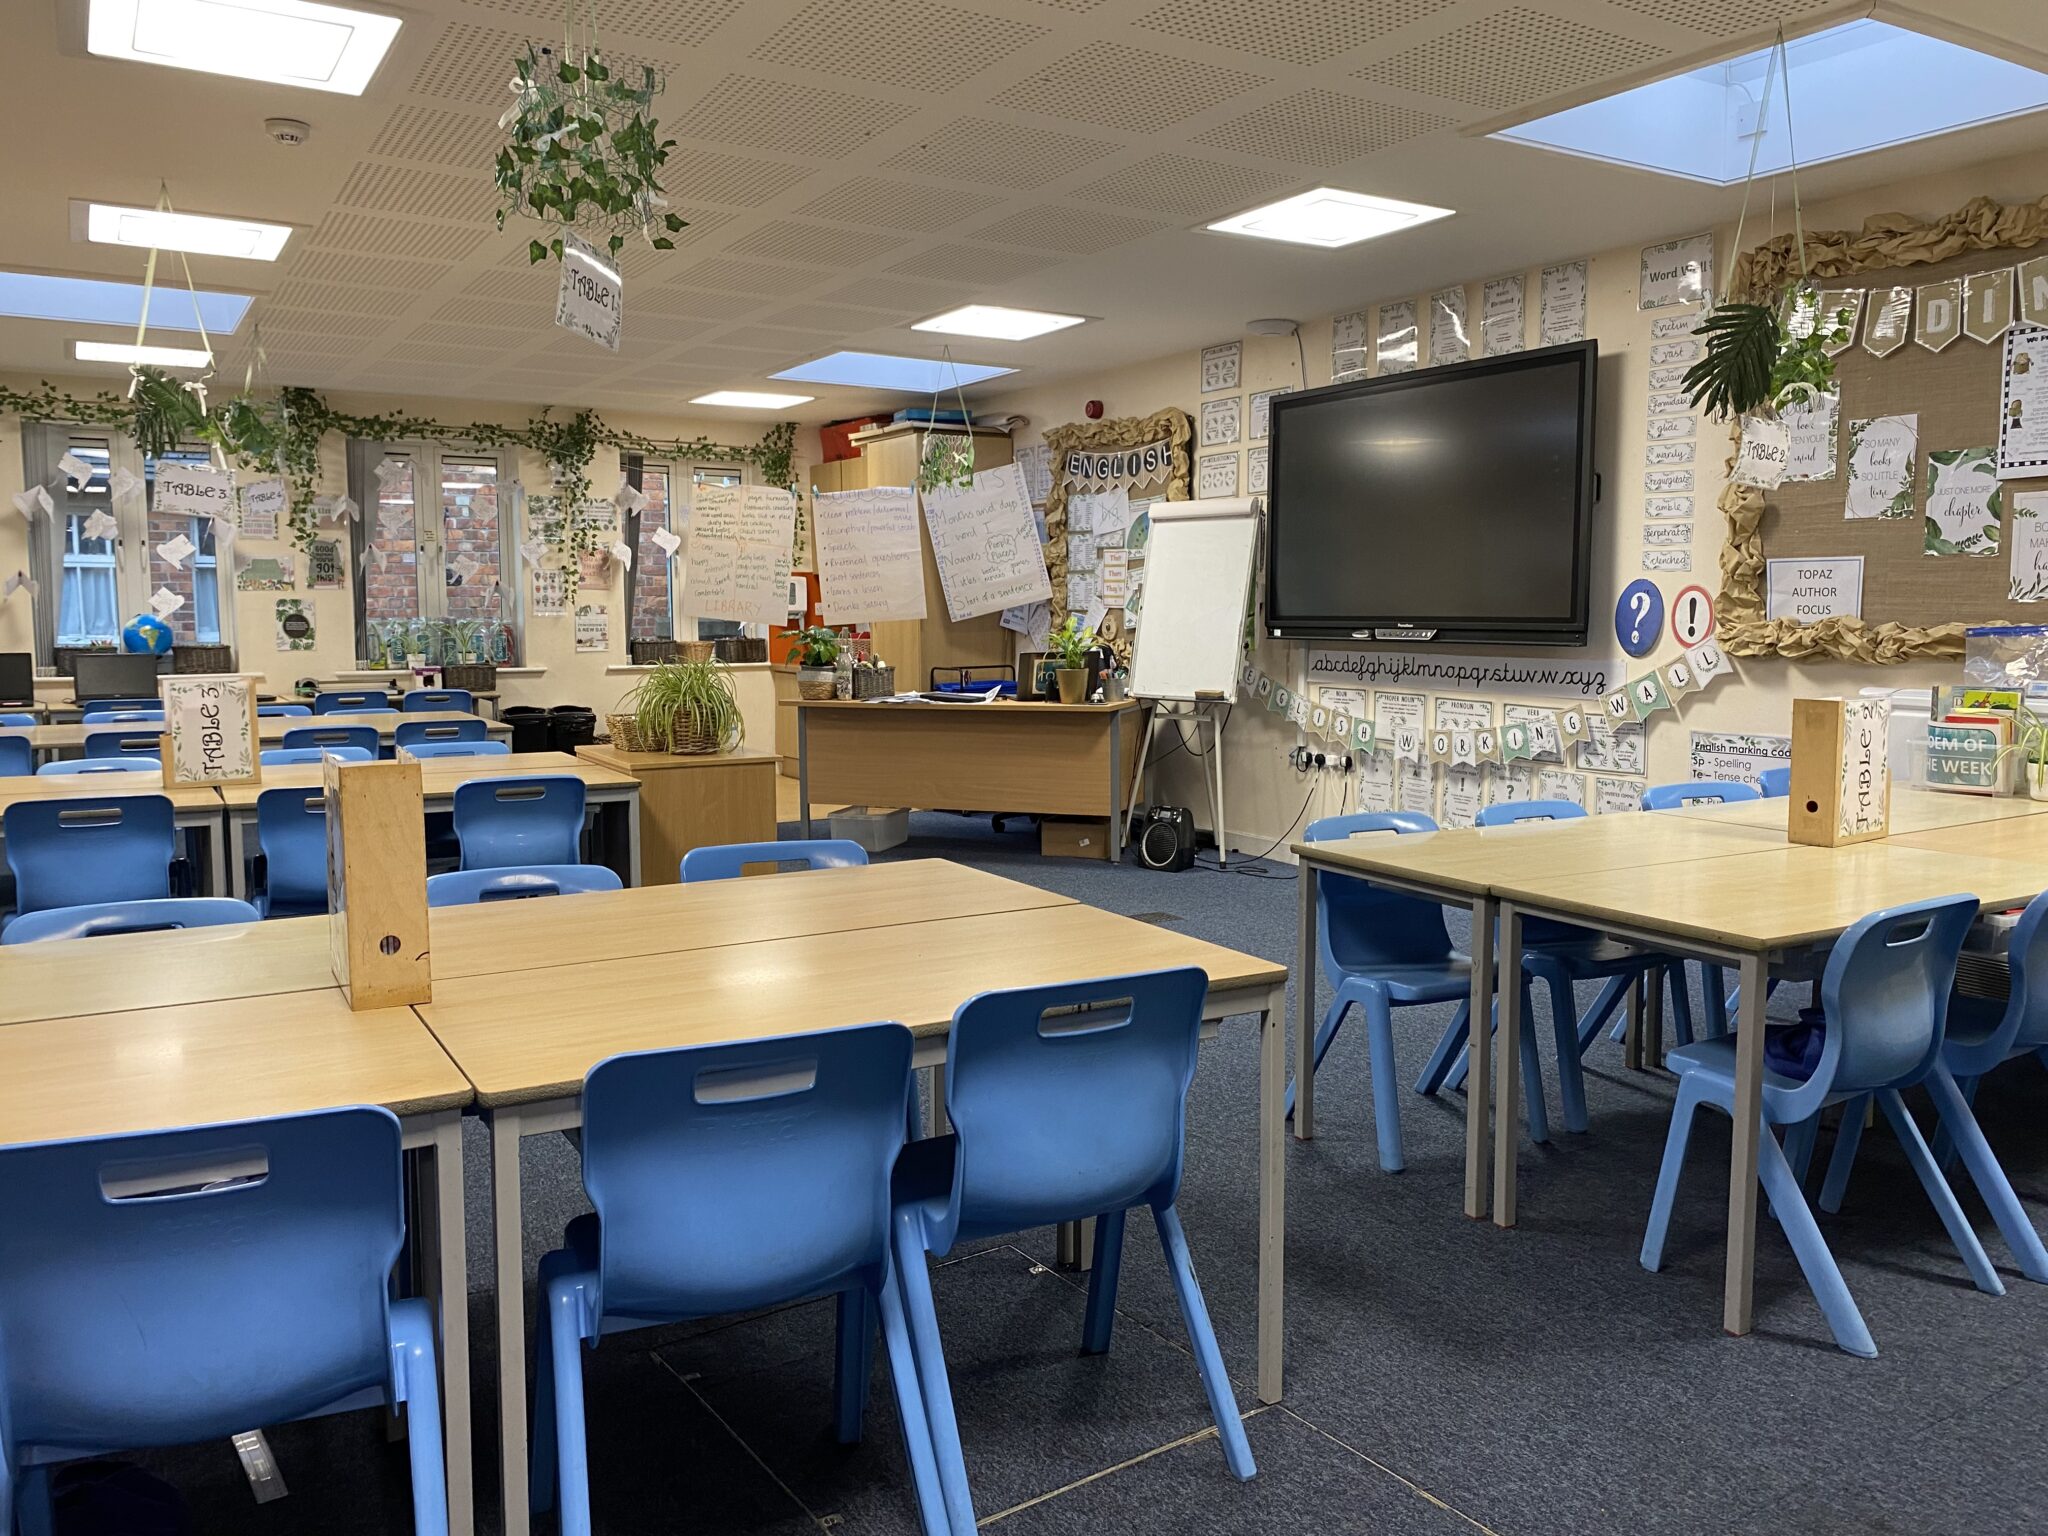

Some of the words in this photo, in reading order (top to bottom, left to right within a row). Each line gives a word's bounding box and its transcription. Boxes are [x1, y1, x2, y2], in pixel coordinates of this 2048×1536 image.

[1649, 267, 1678, 282] Word
[571, 269, 609, 308] TABLE
[611, 295, 616, 311] 1
[1659, 320, 1688, 333] victim
[1663, 347, 1684, 358] vast
[1657, 422, 1680, 436] glide
[1806, 433, 1826, 443] YOUR
[1864, 439, 1877, 449] SO
[1877, 437, 1901, 448] MANY
[1655, 448, 1687, 461] warily
[1747, 440, 1778, 462] TABLE
[1778, 451, 1785, 463] 2
[1793, 451, 1817, 465] mind
[1069, 444, 1173, 478] ENGLISH
[1869, 452, 1892, 467] books
[1861, 472, 1874, 482] SO
[1874, 470, 1899, 481] LITTLE
[163, 481, 216, 498] TABLE
[218, 488, 227, 499] 3
[1869, 485, 1889, 500] time
[1937, 486, 1954, 496] JUST
[1954, 486, 1970, 495] ONE
[1970, 484, 1992, 494] MORE
[250, 492, 275, 503] TABLE
[1655, 501, 1682, 511] amble
[1944, 497, 1982, 528] chapter
[934, 510, 974, 528] Months
[976, 502, 996, 517] and
[1650, 556, 1687, 566] clenched
[1798, 569, 1833, 580] TOPAZ
[1792, 587, 1837, 597] AUTHOR
[704, 599, 762, 617] LIBRARY
[1796, 605, 1832, 615] FOCUS
[201, 687, 220, 699] 3
[1451, 701, 1474, 710] PRONOUN
[1863, 706, 1874, 720] 2
[200, 703, 226, 775] TABLE
[1928, 735, 1958, 752] OEM
[1963, 738, 1988, 752] OF
[1694, 741, 1727, 753] English
[1728, 745, 1768, 757] marking
[1770, 748, 1791, 758] cod
[1692, 755, 1705, 766] Sp
[1713, 757, 1752, 772] Spelling
[1941, 759, 1992, 776] WEEK
[1692, 769, 1704, 779] Te
[1713, 770, 1740, 783] Tense
[1743, 773, 1760, 785] che
[1856, 728, 1872, 830] TABLE
